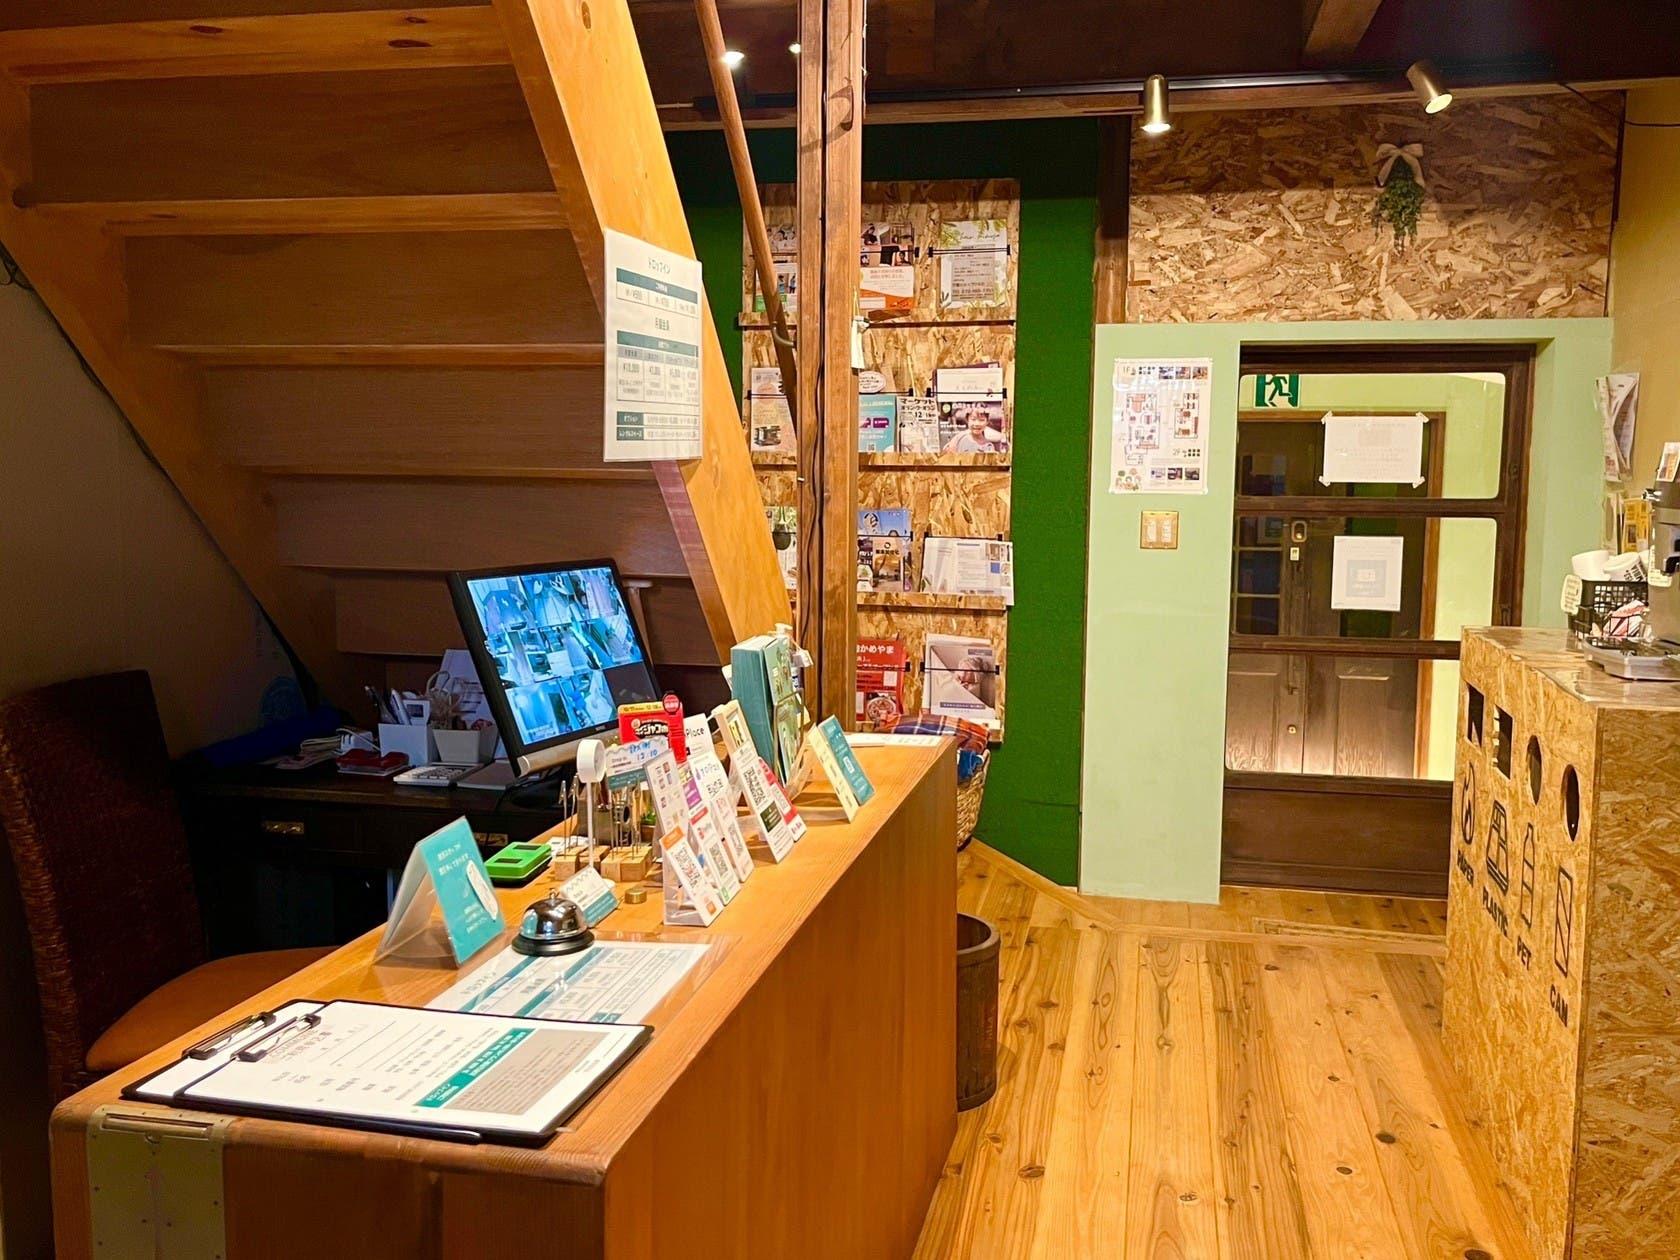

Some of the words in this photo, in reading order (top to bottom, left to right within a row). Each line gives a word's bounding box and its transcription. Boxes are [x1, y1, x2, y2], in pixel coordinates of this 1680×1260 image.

[685, 728, 705, 738] Place
[1456, 850, 1474, 888] PAPER
[1482, 887, 1508, 937] PLASTIC
[1516, 935, 1532, 972] PET
[1550, 983, 1568, 1028] CAN
